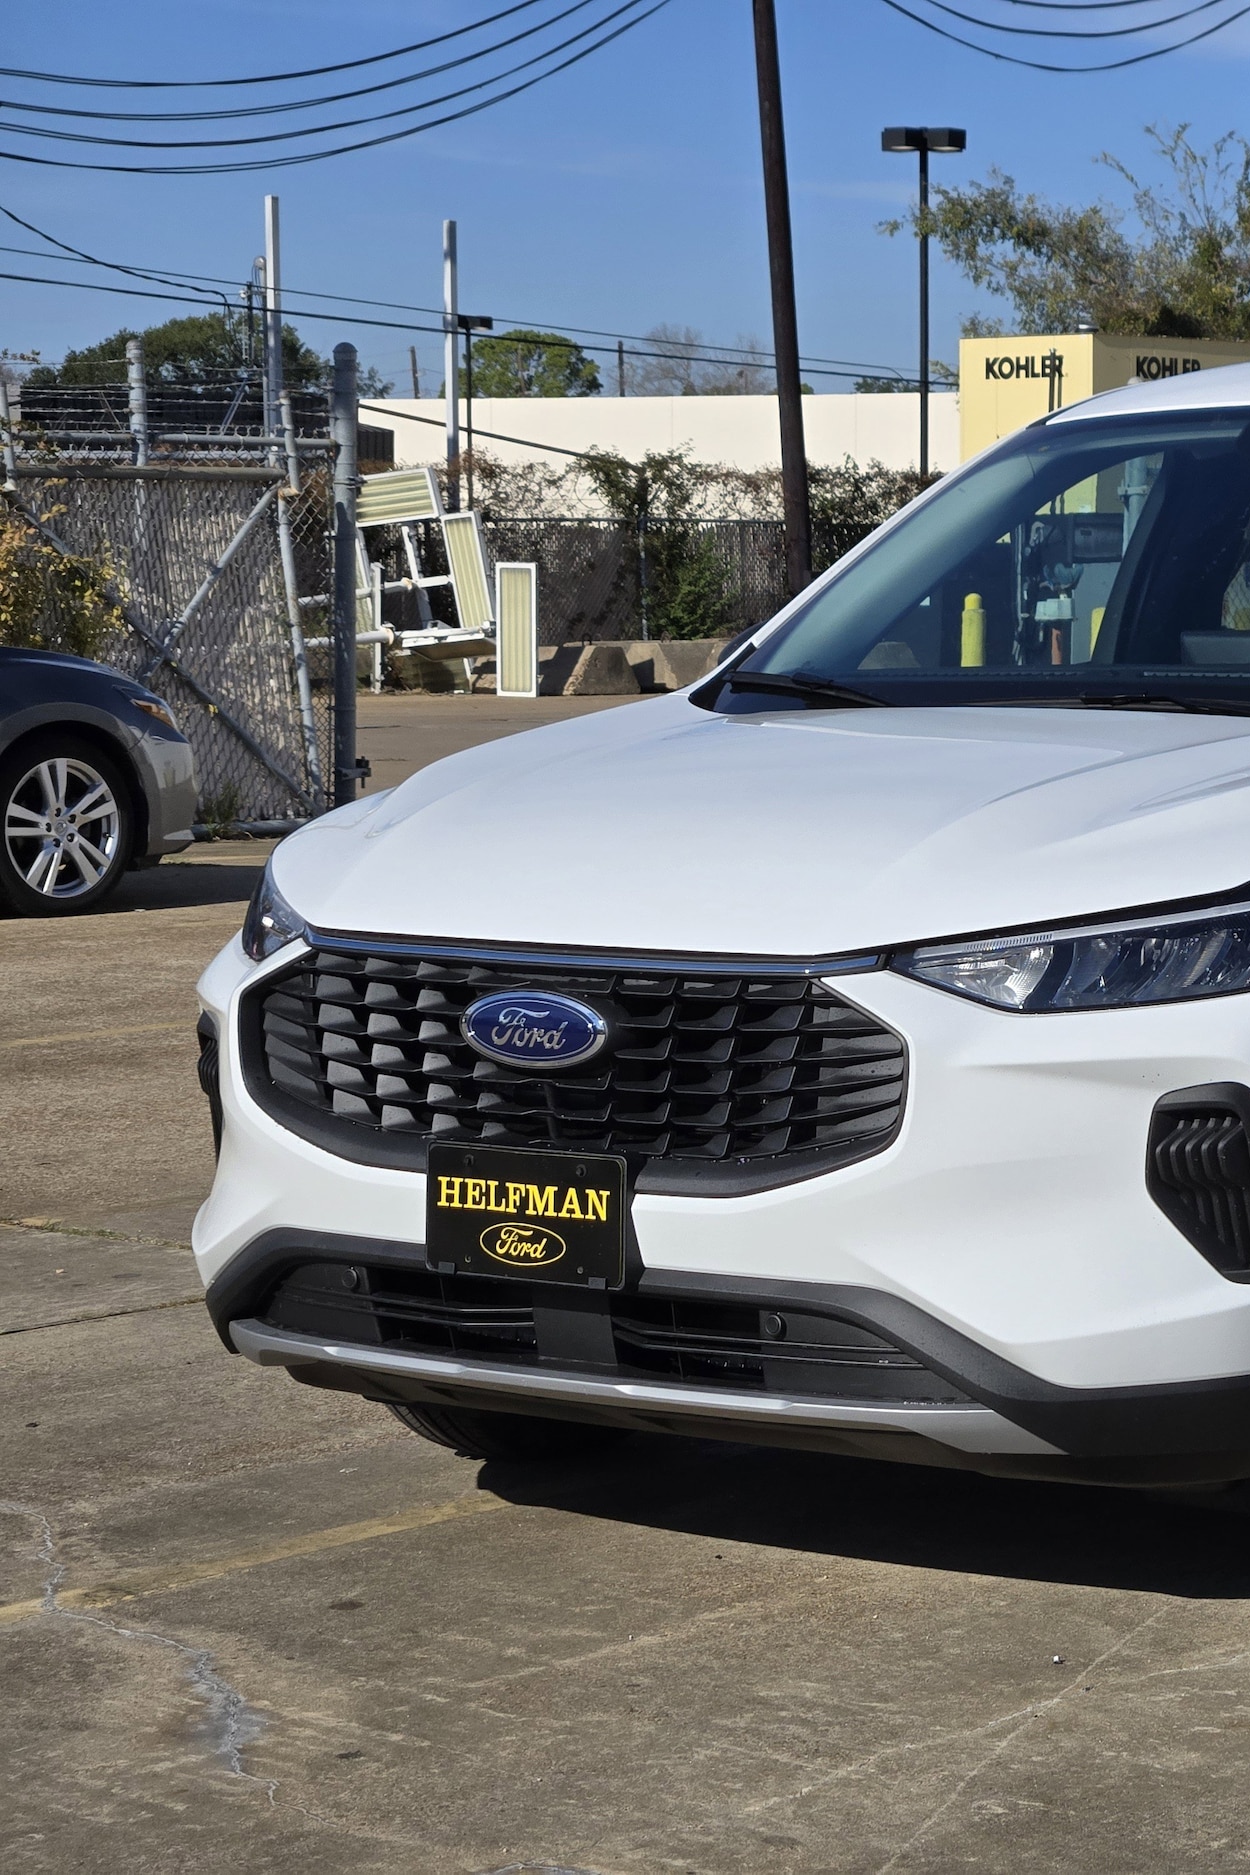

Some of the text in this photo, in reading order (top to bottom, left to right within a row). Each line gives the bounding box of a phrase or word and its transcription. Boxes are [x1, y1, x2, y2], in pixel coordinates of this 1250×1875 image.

[985, 355, 1064, 379] KOHLER
[491, 1007, 567, 1049] Ford
[437, 1176, 610, 1221] HELFMAN
[495, 1227, 547, 1259] Ford
